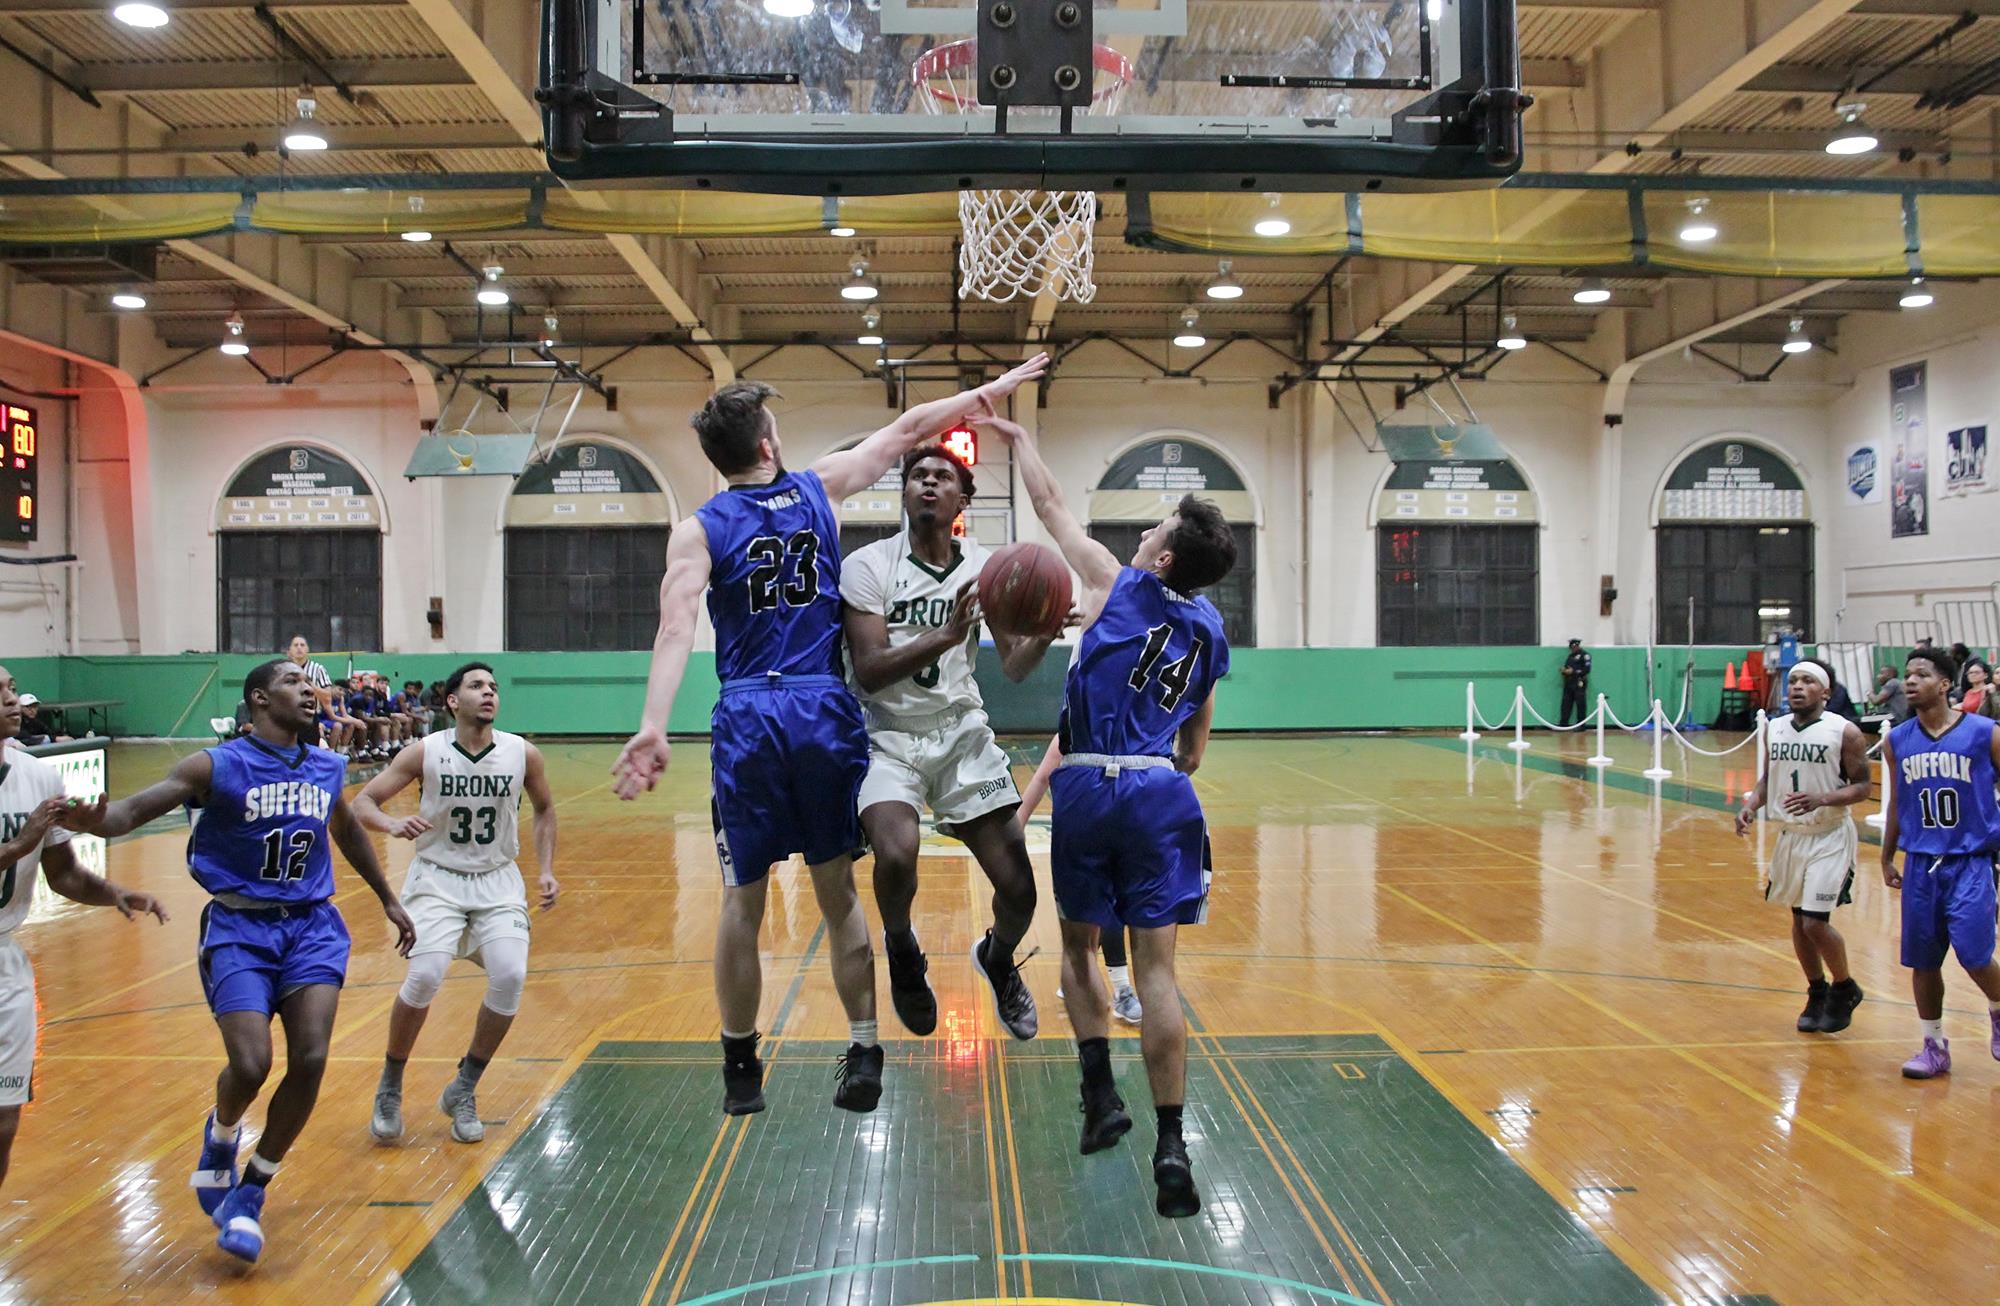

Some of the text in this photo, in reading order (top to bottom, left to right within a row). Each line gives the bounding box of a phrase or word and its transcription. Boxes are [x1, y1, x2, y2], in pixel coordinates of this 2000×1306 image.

[13, 422, 36, 457] 80
[282, 480, 315, 488] BASEBALL
[757, 488, 802, 511] ARKS
[746, 528, 820, 615] 23
[888, 596, 955, 629] BRO
[1128, 621, 1204, 714] 14
[1770, 742, 1829, 764] BRONX
[1901, 752, 1973, 785] SUFFOLK
[439, 773, 514, 798] BRONX
[978, 776, 1009, 801] BRONX
[1790, 768, 1800, 793] 1
[1918, 787, 1959, 829] 10
[449, 806, 497, 845] 33
[260, 828, 316, 881] 12
[0, 1075, 25, 1089] RONX
